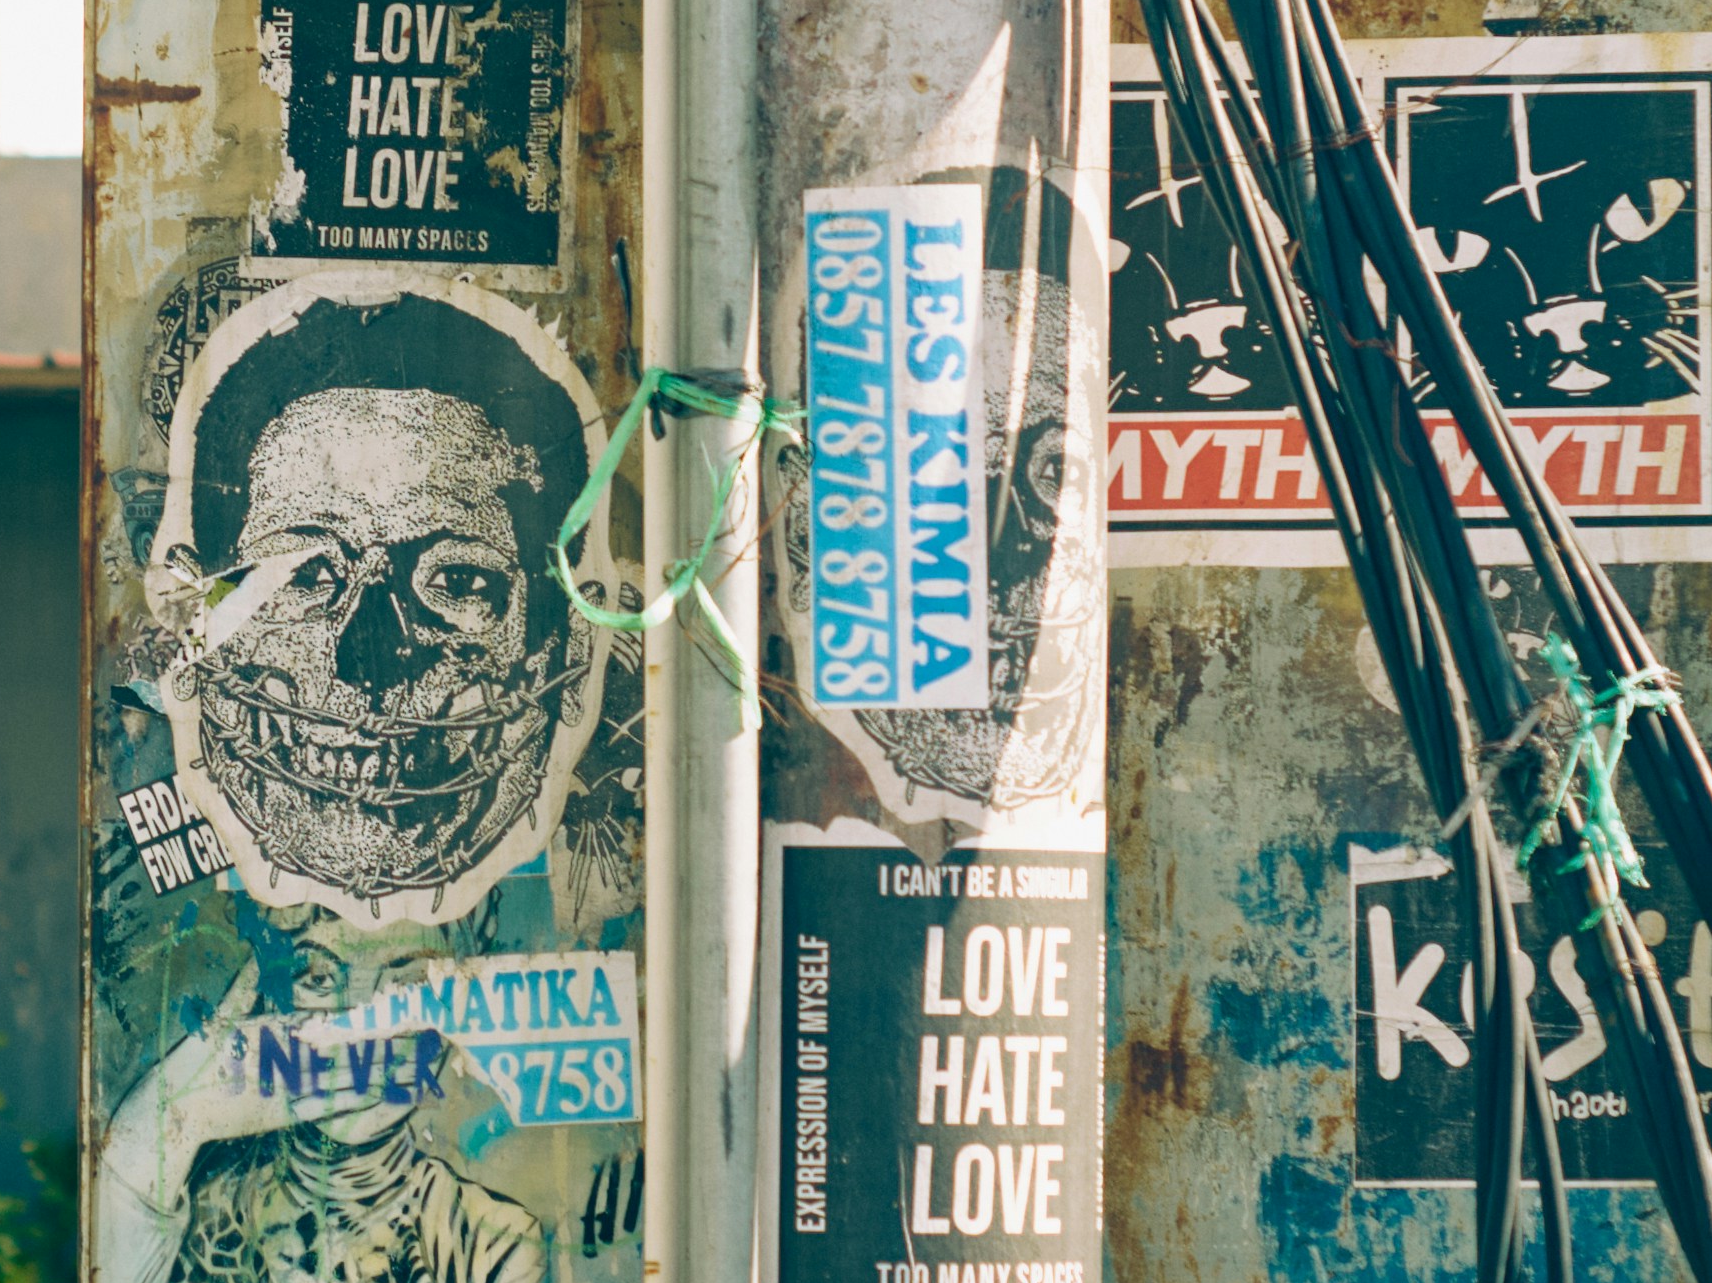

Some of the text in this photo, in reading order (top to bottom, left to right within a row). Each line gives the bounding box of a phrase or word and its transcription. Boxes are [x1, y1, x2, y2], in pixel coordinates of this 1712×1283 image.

[352, 2, 474, 66] LOVE
[347, 74, 466, 138] HATE
[341, 147, 465, 211] LOVE
[318, 225, 354, 248] TOO
[358, 226, 412, 250] MANY
[812, 217, 890, 697] 0857 7878 8758
[903, 218, 973, 694] LES KIMIA
[140, 834, 195, 895] FDW
[879, 864, 888, 896] I
[893, 864, 963, 898] CAN'T
[965, 865, 995, 898] BE
[997, 865, 1015, 899] A
[922, 925, 1072, 1017] LOVE
[257, 1024, 445, 1106] NEVER
[795, 933, 830, 1233] EXPRESSION OF MYSELF
[917, 1036, 1068, 1126] HATE
[911, 1143, 1066, 1236] LOVE
